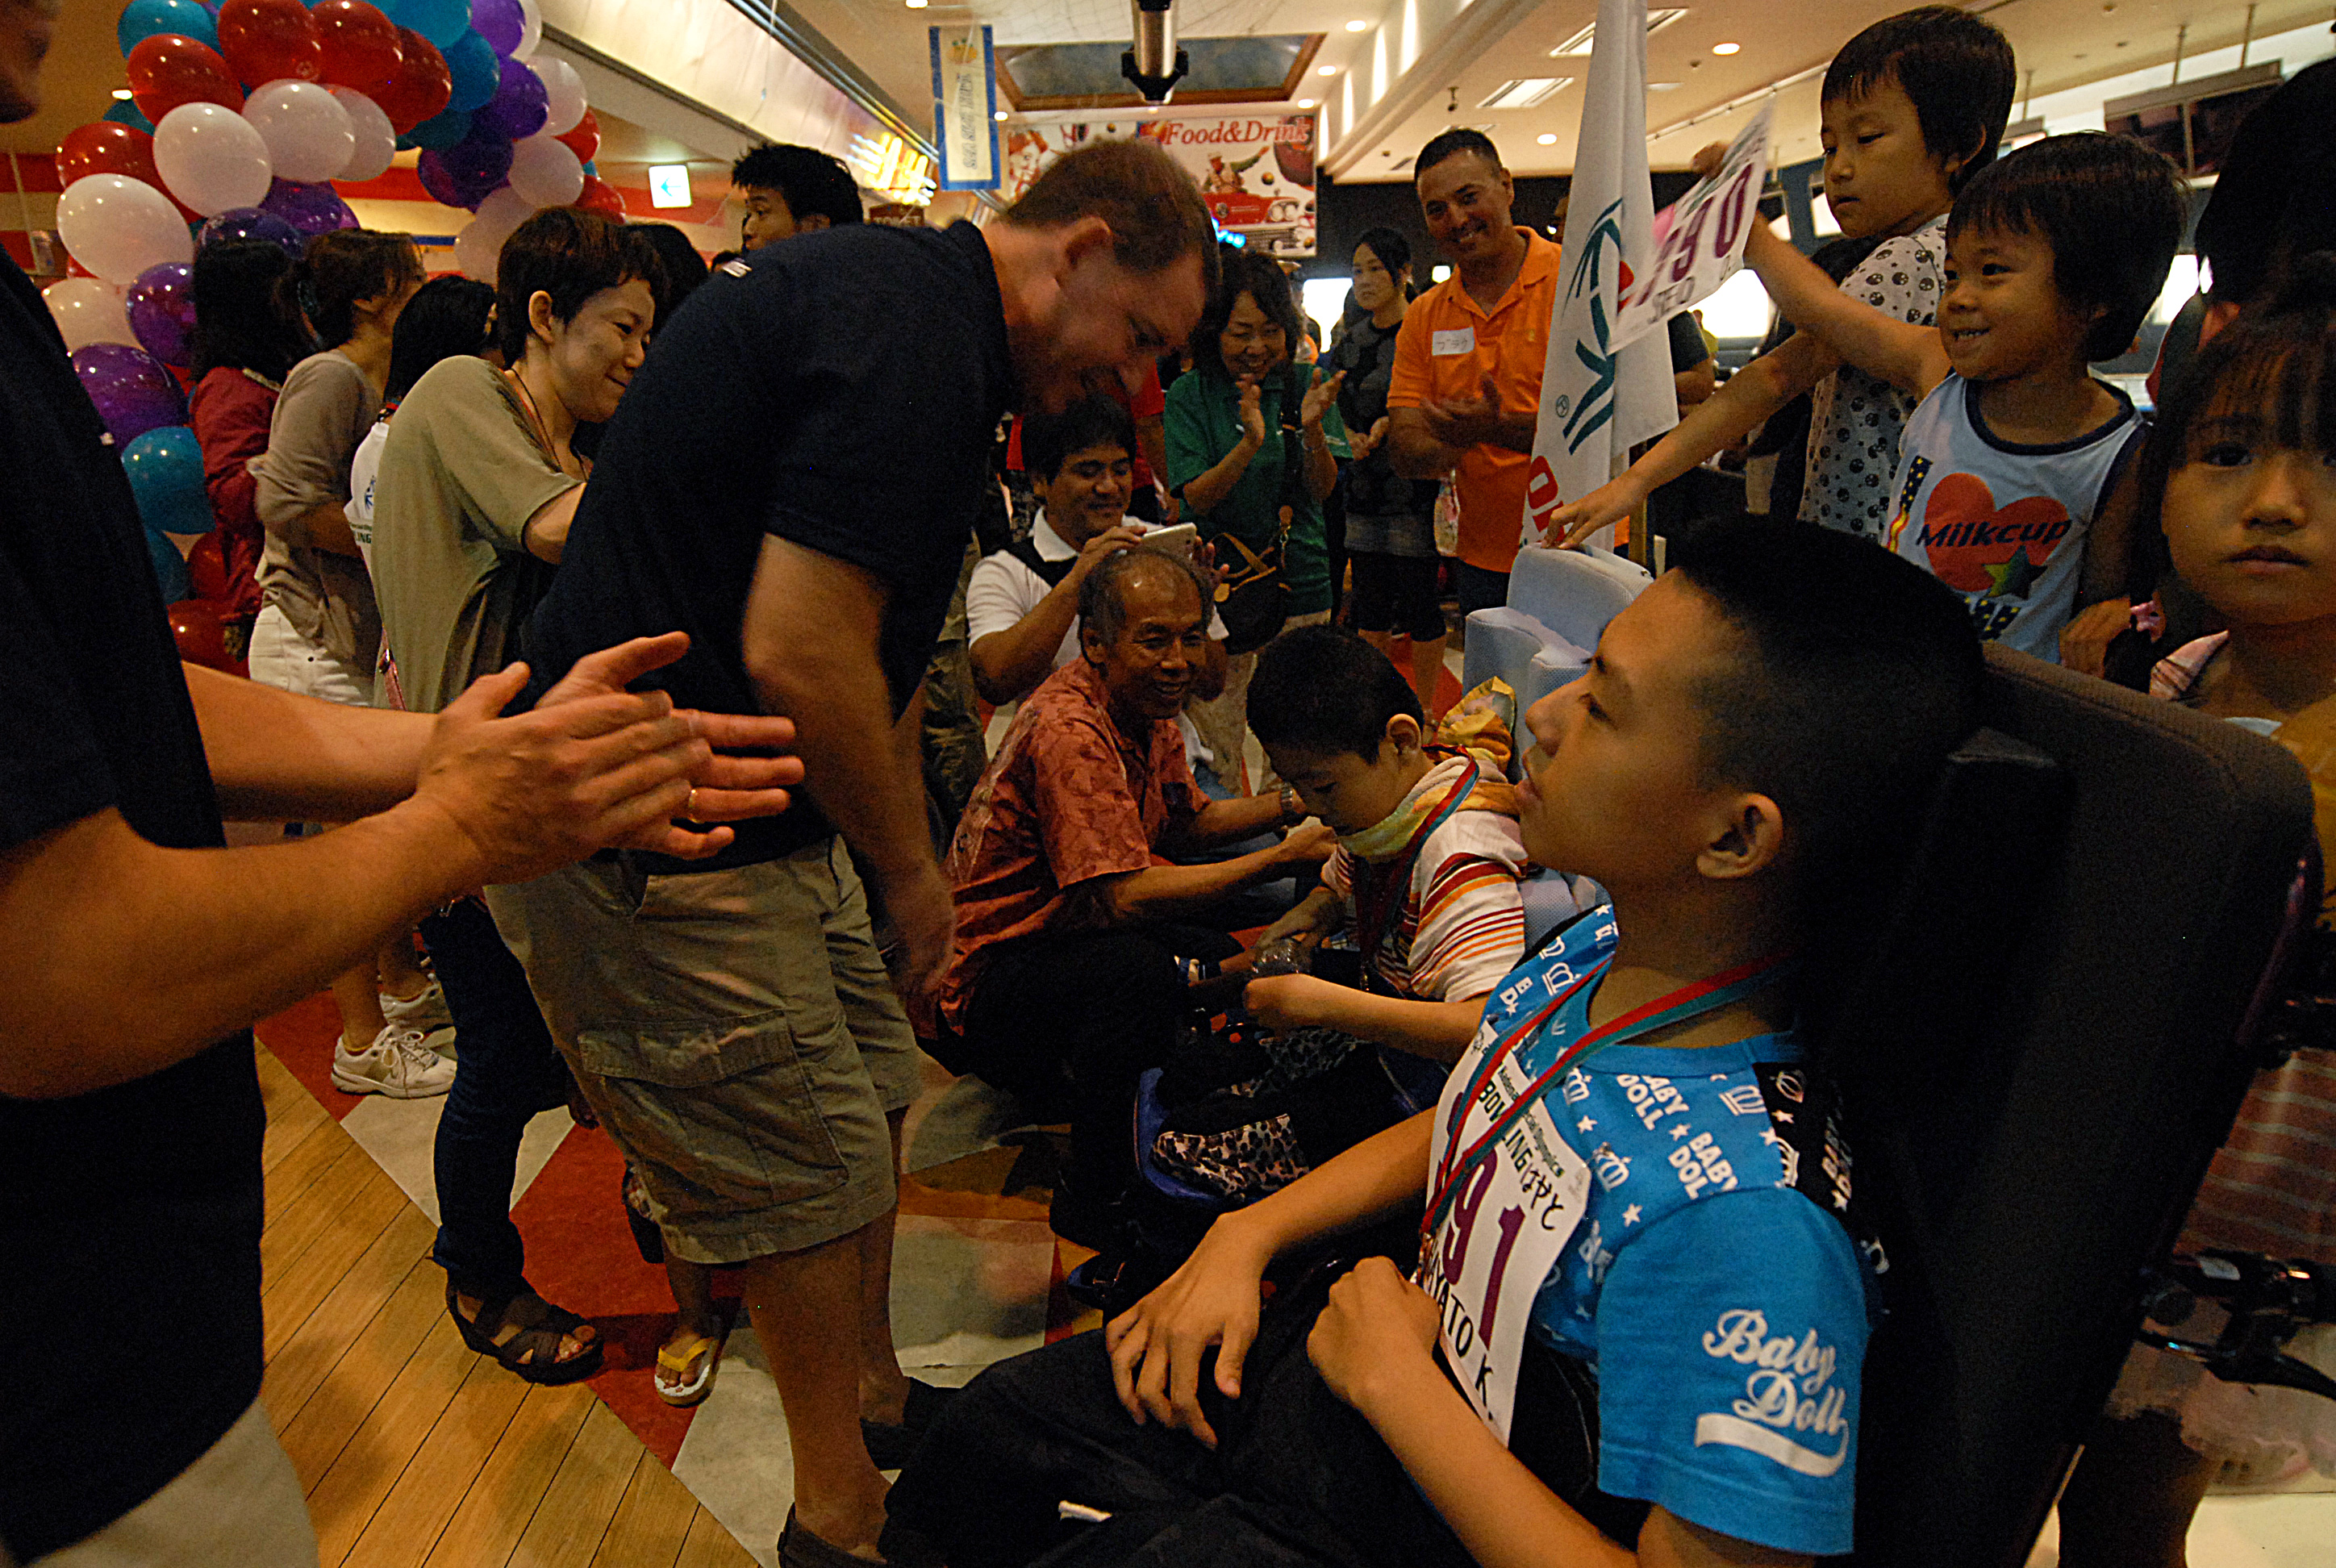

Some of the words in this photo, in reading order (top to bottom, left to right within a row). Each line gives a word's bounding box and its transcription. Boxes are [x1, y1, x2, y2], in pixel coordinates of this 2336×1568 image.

[1161, 120, 1308, 145] Food&Drink
[1916, 519, 2073, 548] Milkcup
[1616, 1074, 1664, 1131] DOLL
[1641, 1074, 1690, 1116] ABY
[1478, 1080, 1534, 1173] BOING
[1668, 1145, 1708, 1200] DOL
[1702, 1308, 1837, 1395] Baby
[1732, 1369, 1847, 1437] Doll
